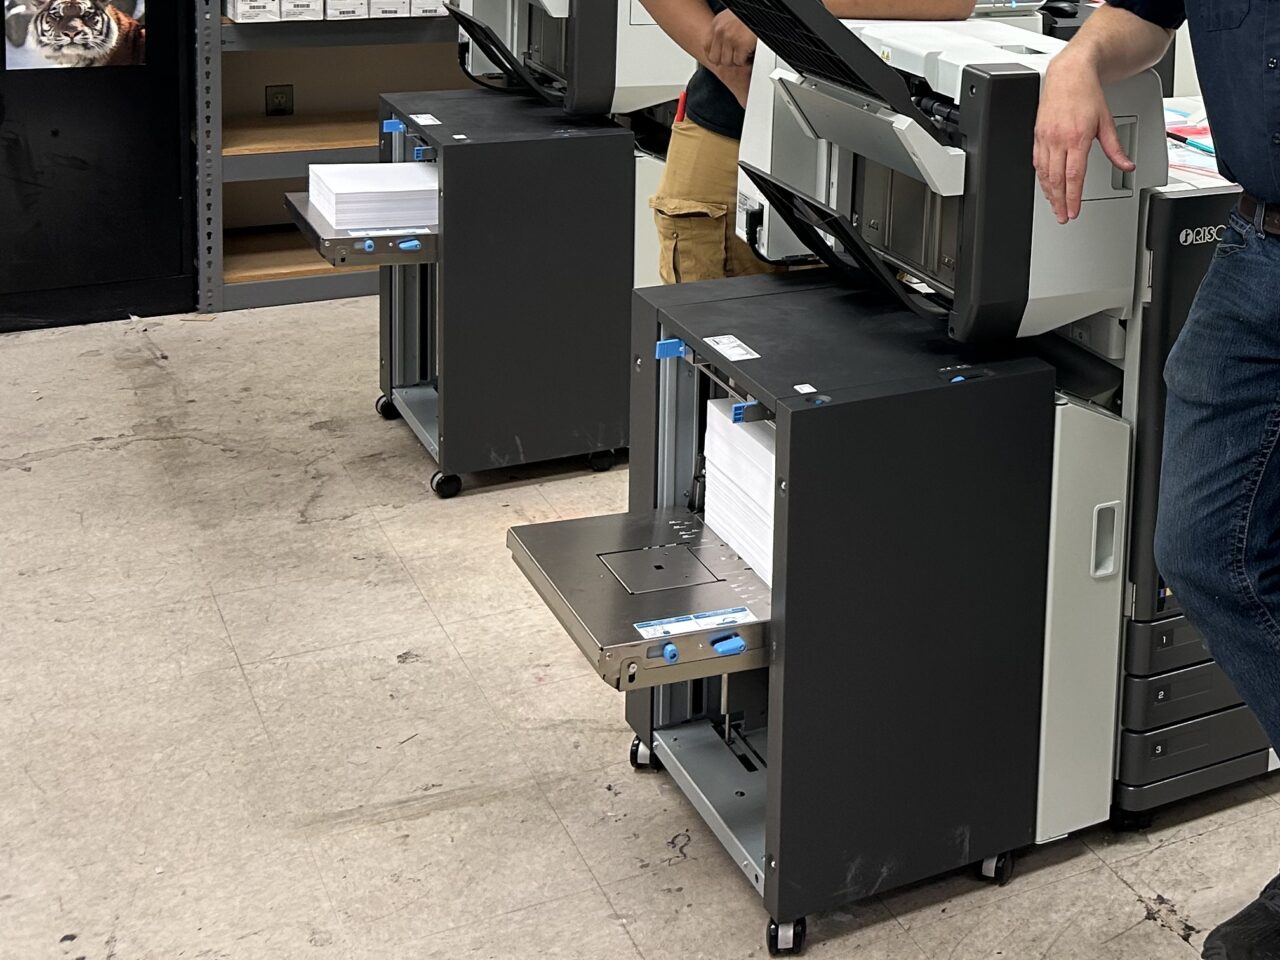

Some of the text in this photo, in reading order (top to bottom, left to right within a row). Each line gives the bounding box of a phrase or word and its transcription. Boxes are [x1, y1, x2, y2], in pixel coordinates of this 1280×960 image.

[1162, 636, 1167, 644] 1
[1158, 691, 1164, 699] 2
[1155, 745, 1162, 753] 3
